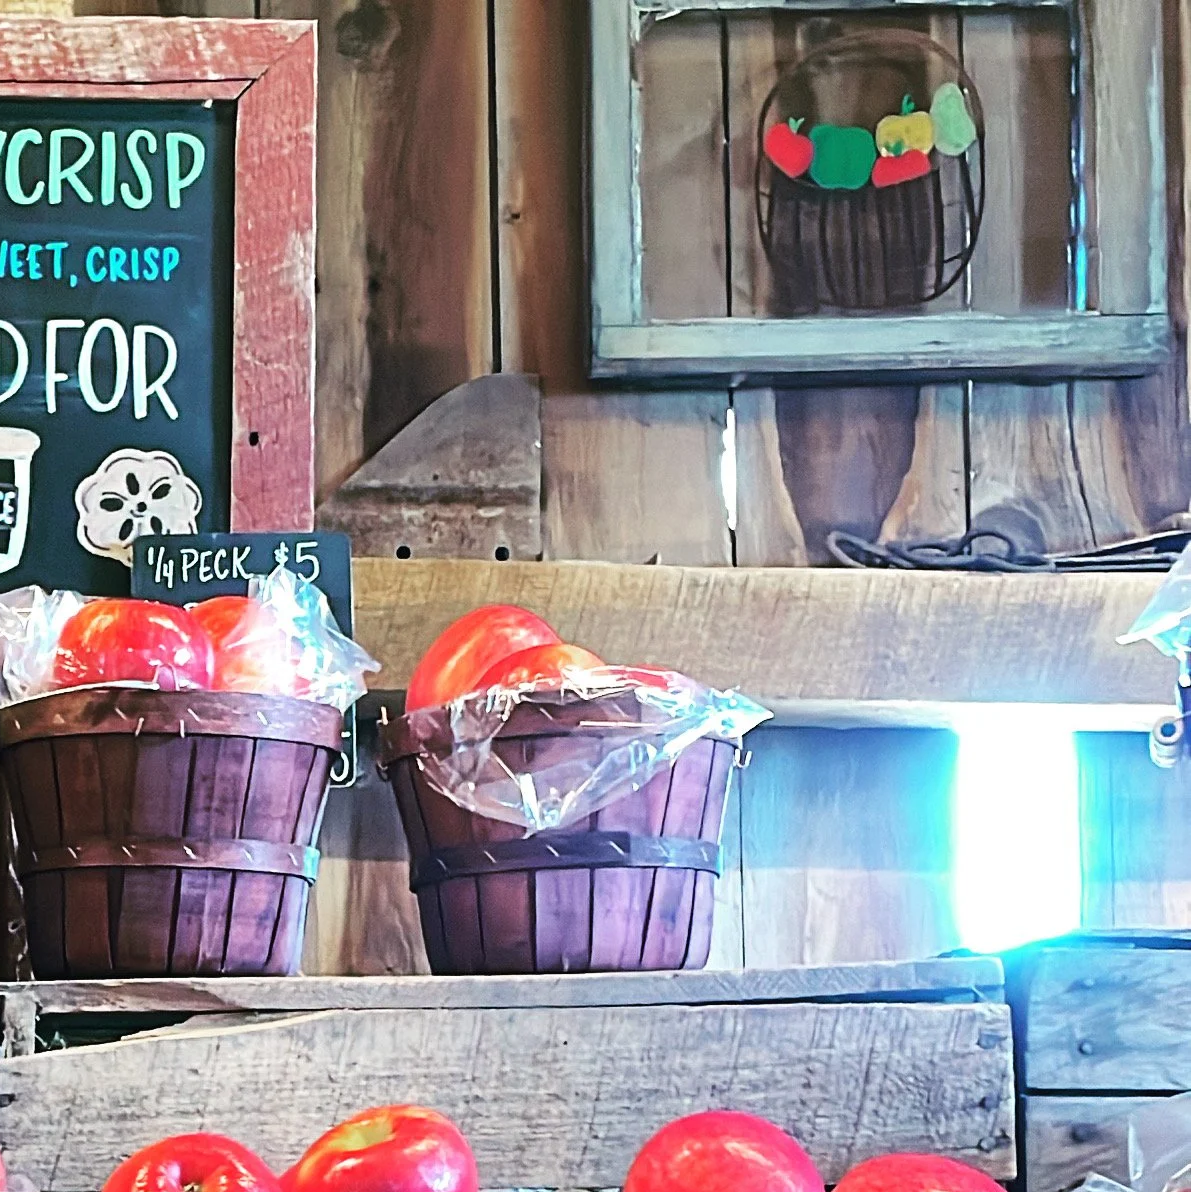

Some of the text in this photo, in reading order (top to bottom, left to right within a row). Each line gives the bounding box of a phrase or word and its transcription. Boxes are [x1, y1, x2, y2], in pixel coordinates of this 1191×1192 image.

[85, 245, 180, 283] CRISP
[45, 318, 179, 421] FOR
[179, 545, 254, 583] PECK
[273, 541, 320, 583] $5
